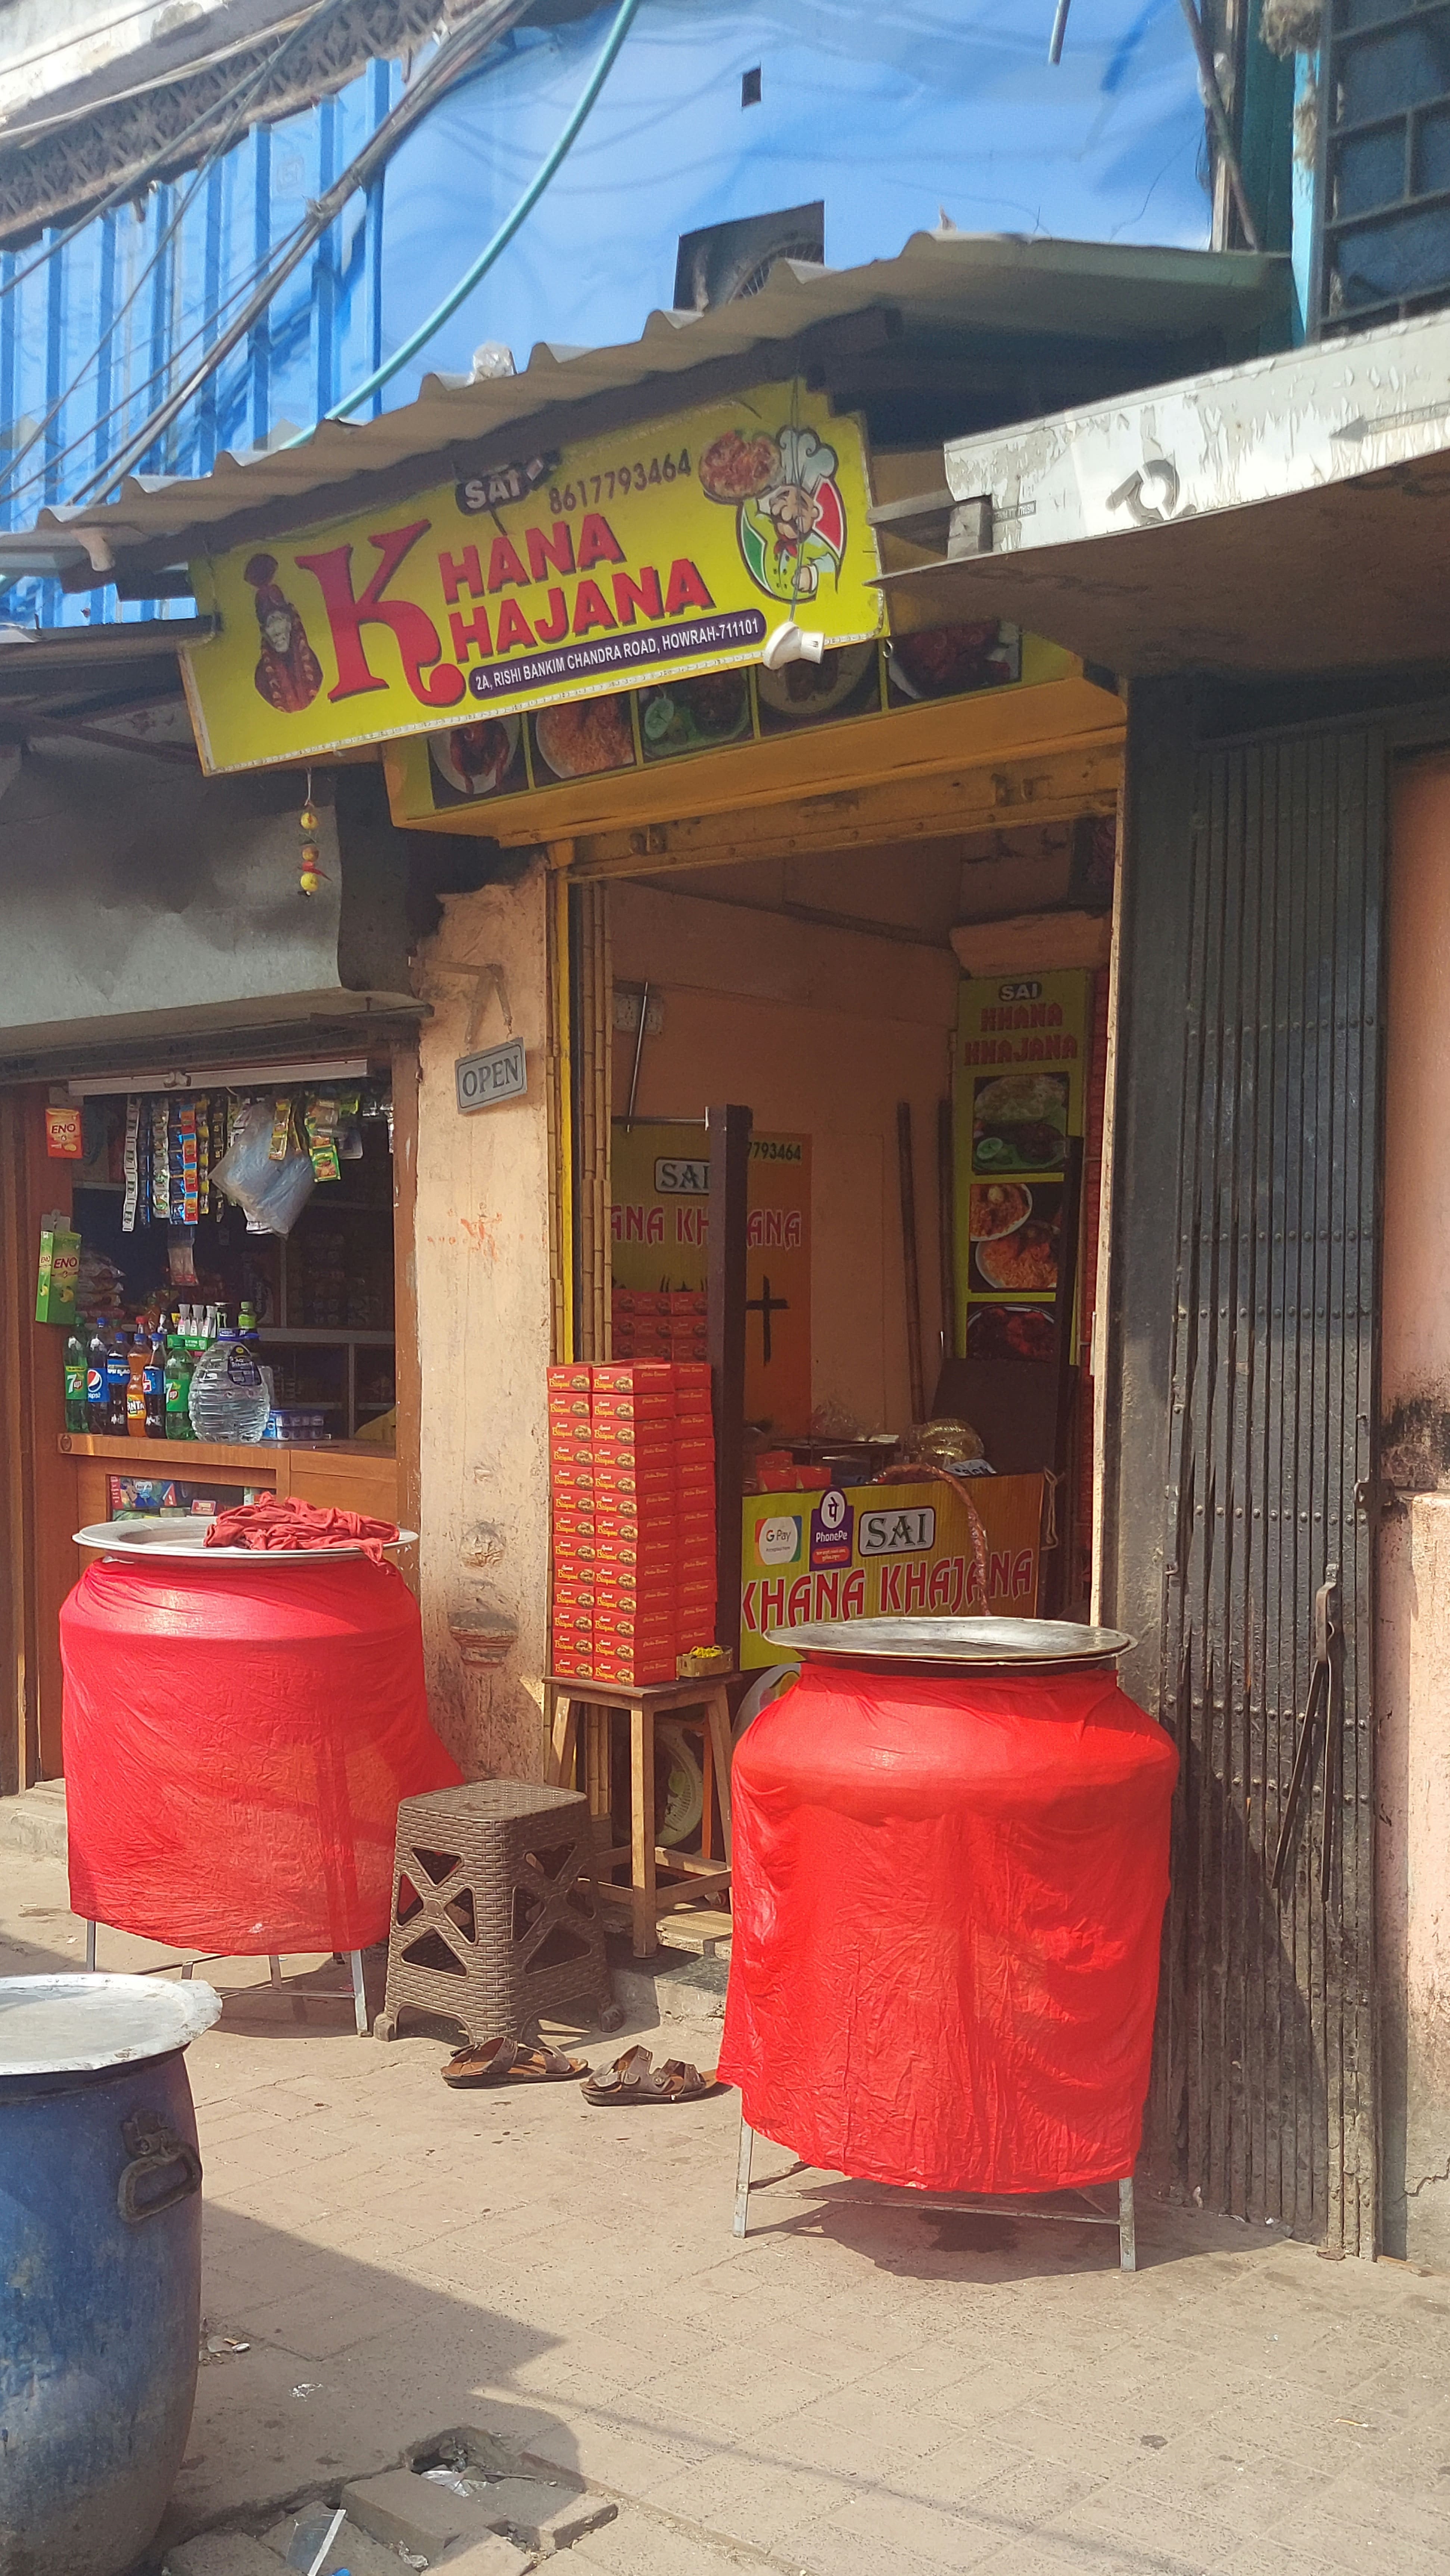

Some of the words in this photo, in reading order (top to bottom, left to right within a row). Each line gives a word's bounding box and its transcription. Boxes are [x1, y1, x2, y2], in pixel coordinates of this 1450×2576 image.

[549, 449, 691, 514] 8617793464
[476, 675, 493, 691] 2A,
[494, 667, 522, 687] RISHI
[524, 657, 565, 681] BANKIM
[567, 645, 621, 669] CHANDRA
[623, 638, 660, 658] ROAD,
[662, 618, 758, 650] HOWRAH-711101
[1000, 984, 1038, 1001] SAI
[462, 1054, 519, 1097] OPEN
[52, 1124, 75, 1134] ENO
[54, 1257, 78, 1269] ENO
[816, 1530, 847, 1543] PhonePe
[866, 1513, 926, 1549] SAI
[742, 1568, 865, 1633] KHANA
